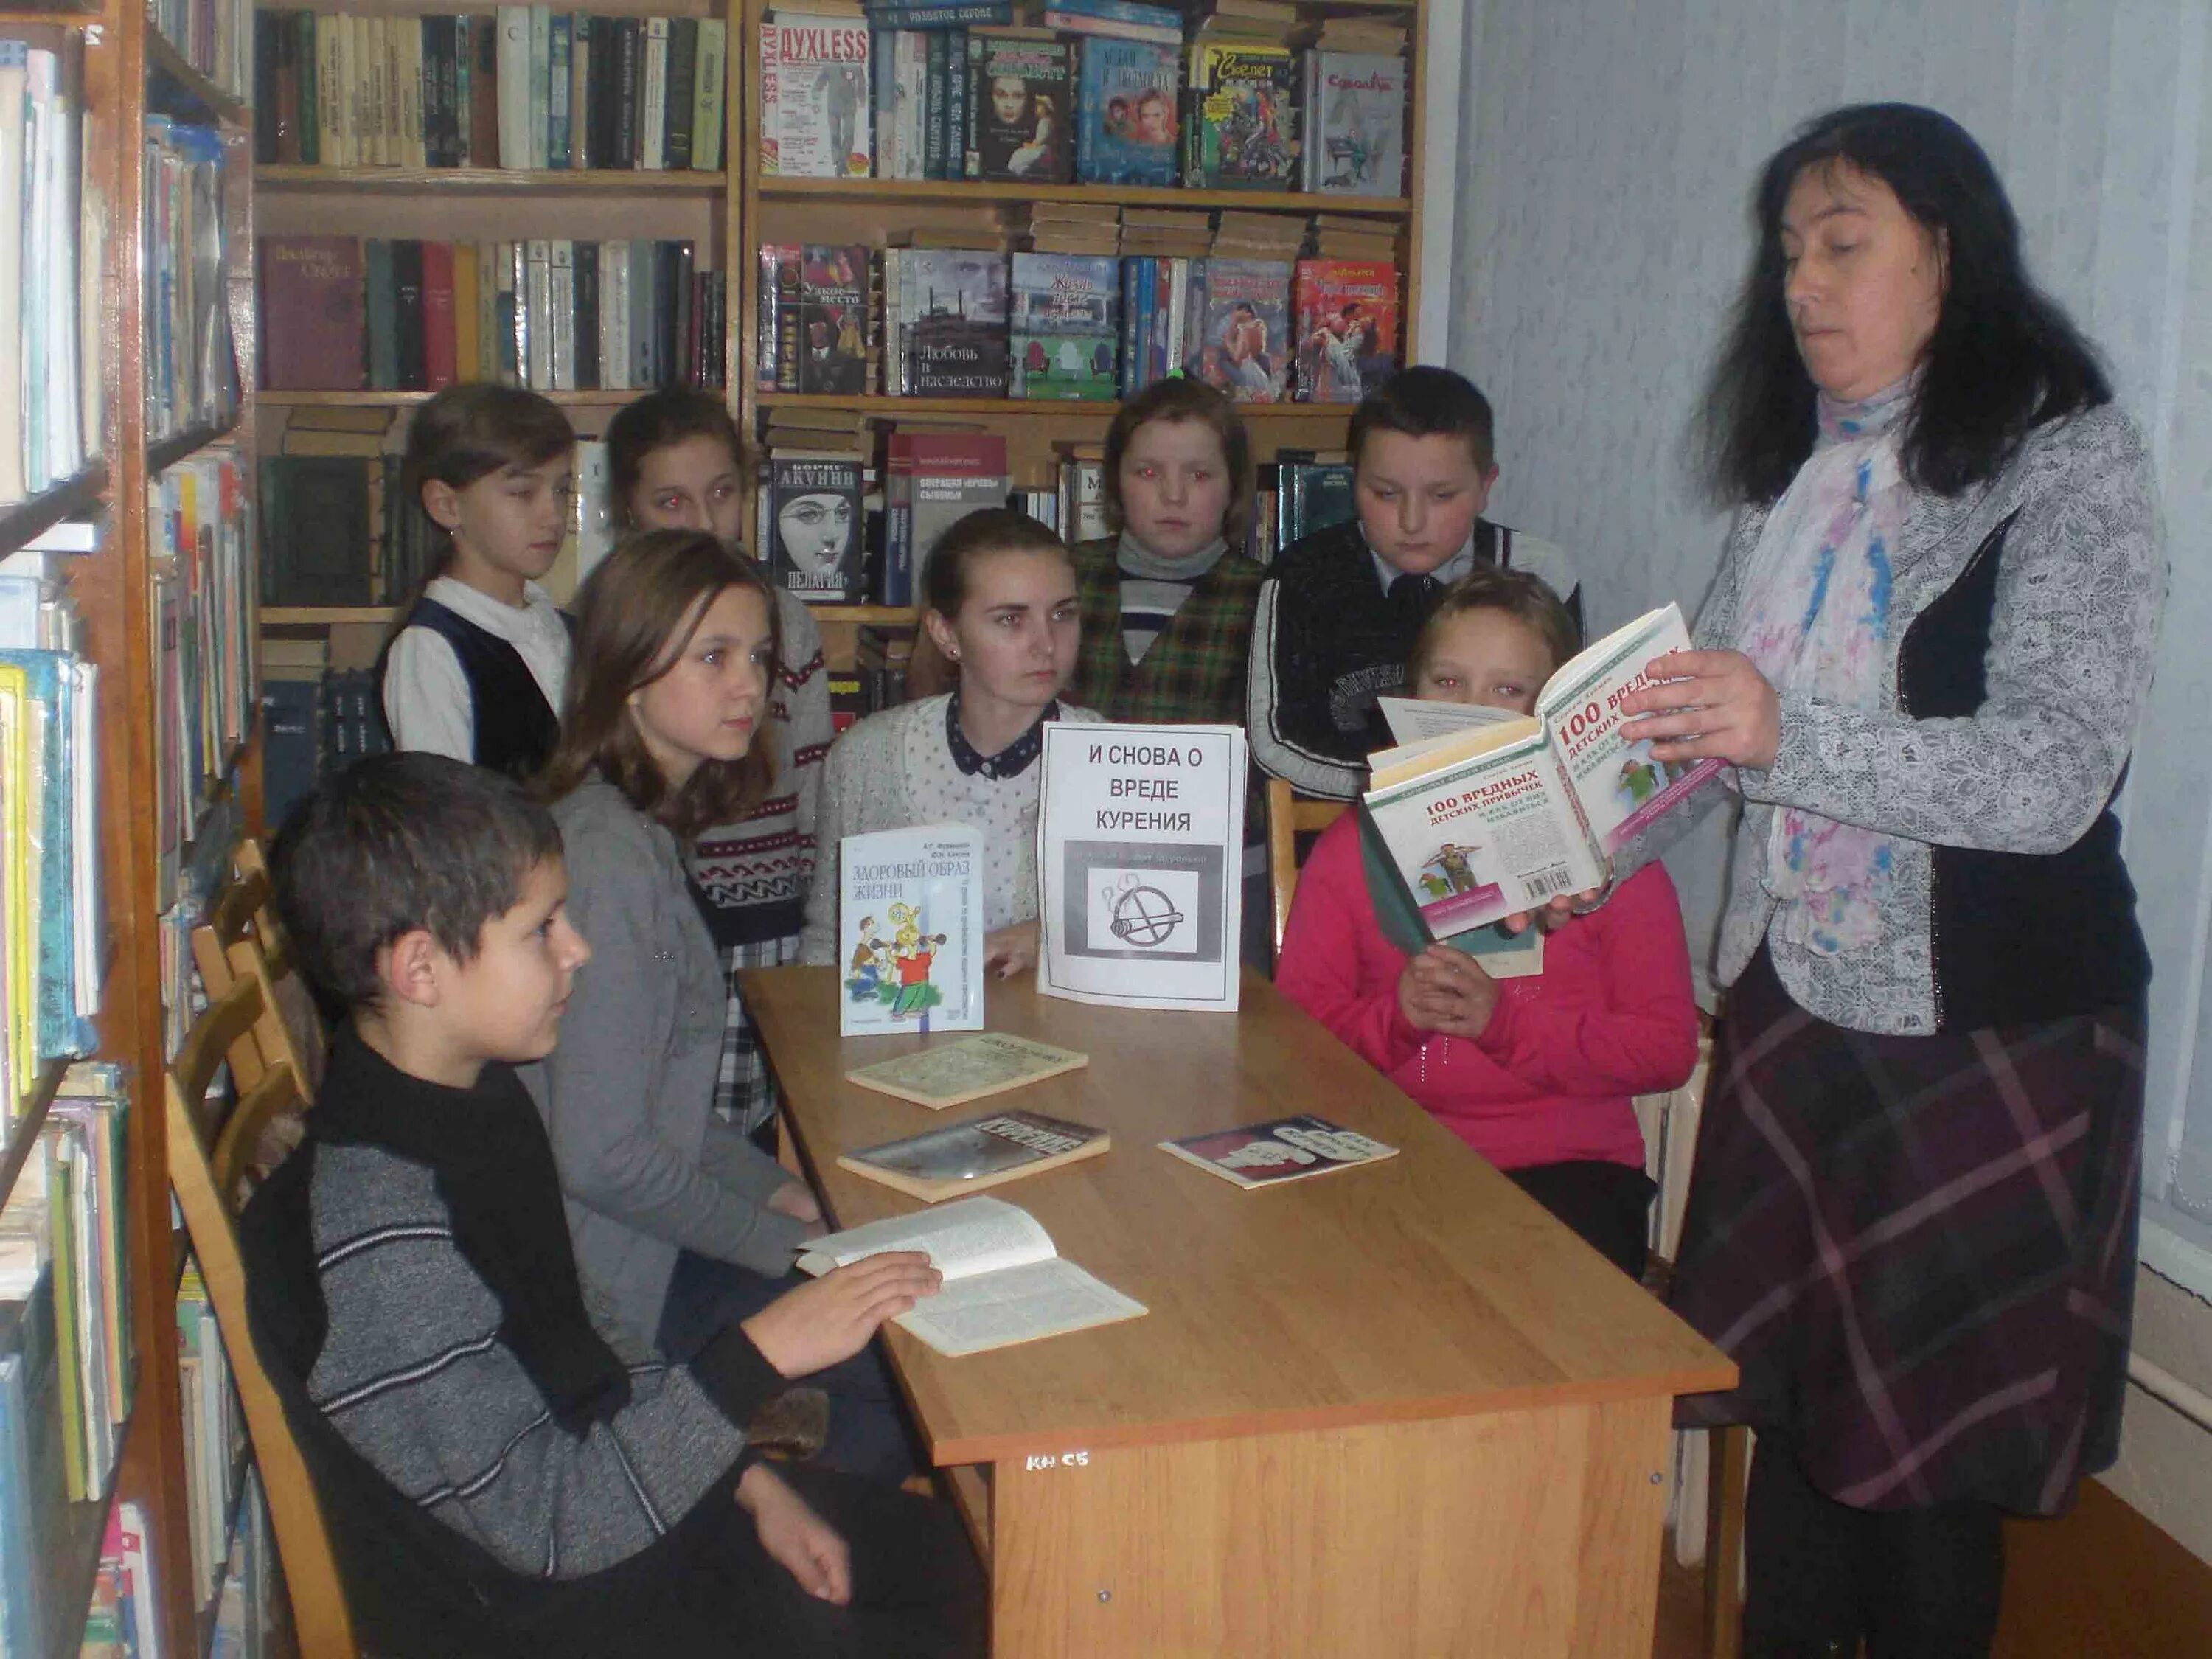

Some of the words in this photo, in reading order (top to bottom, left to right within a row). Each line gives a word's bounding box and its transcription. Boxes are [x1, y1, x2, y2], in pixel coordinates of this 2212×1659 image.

[780, 27, 867, 62] ДУХLESS
[820, 294, 859, 304] место
[920, 344, 979, 361] Любовь
[921, 362, 931, 373] в
[920, 375, 1002, 387] наследство
[781, 470, 854, 488] АКУНИН
[787, 571, 844, 588] ПЕЛАГИЯ
[1559, 701, 1601, 745] 100
[1567, 713, 1621, 761] ДЕТСКИХ
[1089, 744, 1102, 764] И
[1109, 745, 1180, 767] СНОВА
[1188, 747, 1203, 768] О
[1110, 779, 1179, 801] ВРЕДЕ
[1426, 798, 1458, 815] 100
[1462, 769, 1539, 803] ВРЕДНЫХ
[1430, 804, 1481, 826] ДЕТСКИХ
[1482, 782, 1543, 807] ПРИВЫЧЕК
[1096, 810, 1191, 832] КУРЕНИЯ
[852, 860, 925, 882] ЗДОРОВЫЙ
[928, 860, 970, 877] ОБРАЗ
[852, 882, 902, 900] ЖИЗНИ
